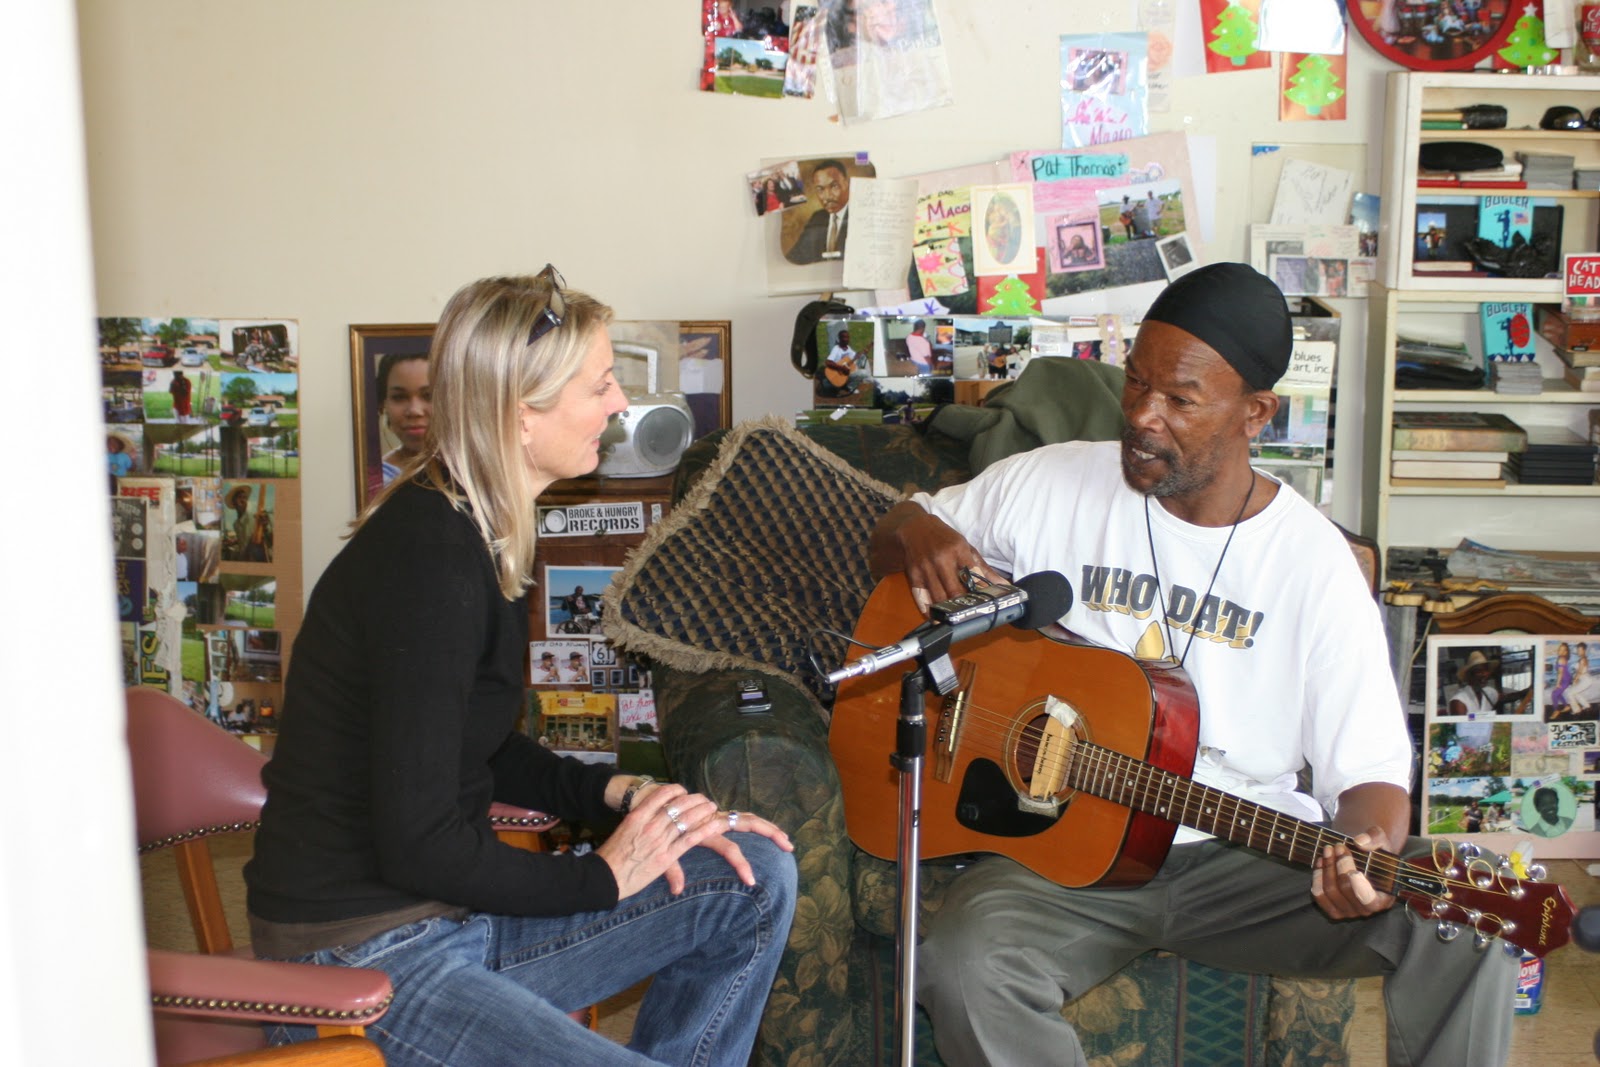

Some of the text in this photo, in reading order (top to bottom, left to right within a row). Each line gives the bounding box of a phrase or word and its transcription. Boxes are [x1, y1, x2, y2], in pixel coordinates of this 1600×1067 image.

[1032, 156, 1063, 181] Pat
[1484, 195, 1529, 209] BUGLER
[927, 200, 971, 222] MACO
[1572, 260, 1600, 275] CAT
[1569, 274, 1600, 289] HEAD
[1486, 302, 1527, 318] BUGLER
[1294, 350, 1322, 362] blues
[568, 505, 638, 519] BROKE & HUNGRY
[570, 517, 640, 532] RECORDS
[1081, 564, 1159, 619] WHO
[1538, 896, 1557, 946] Epiphone
